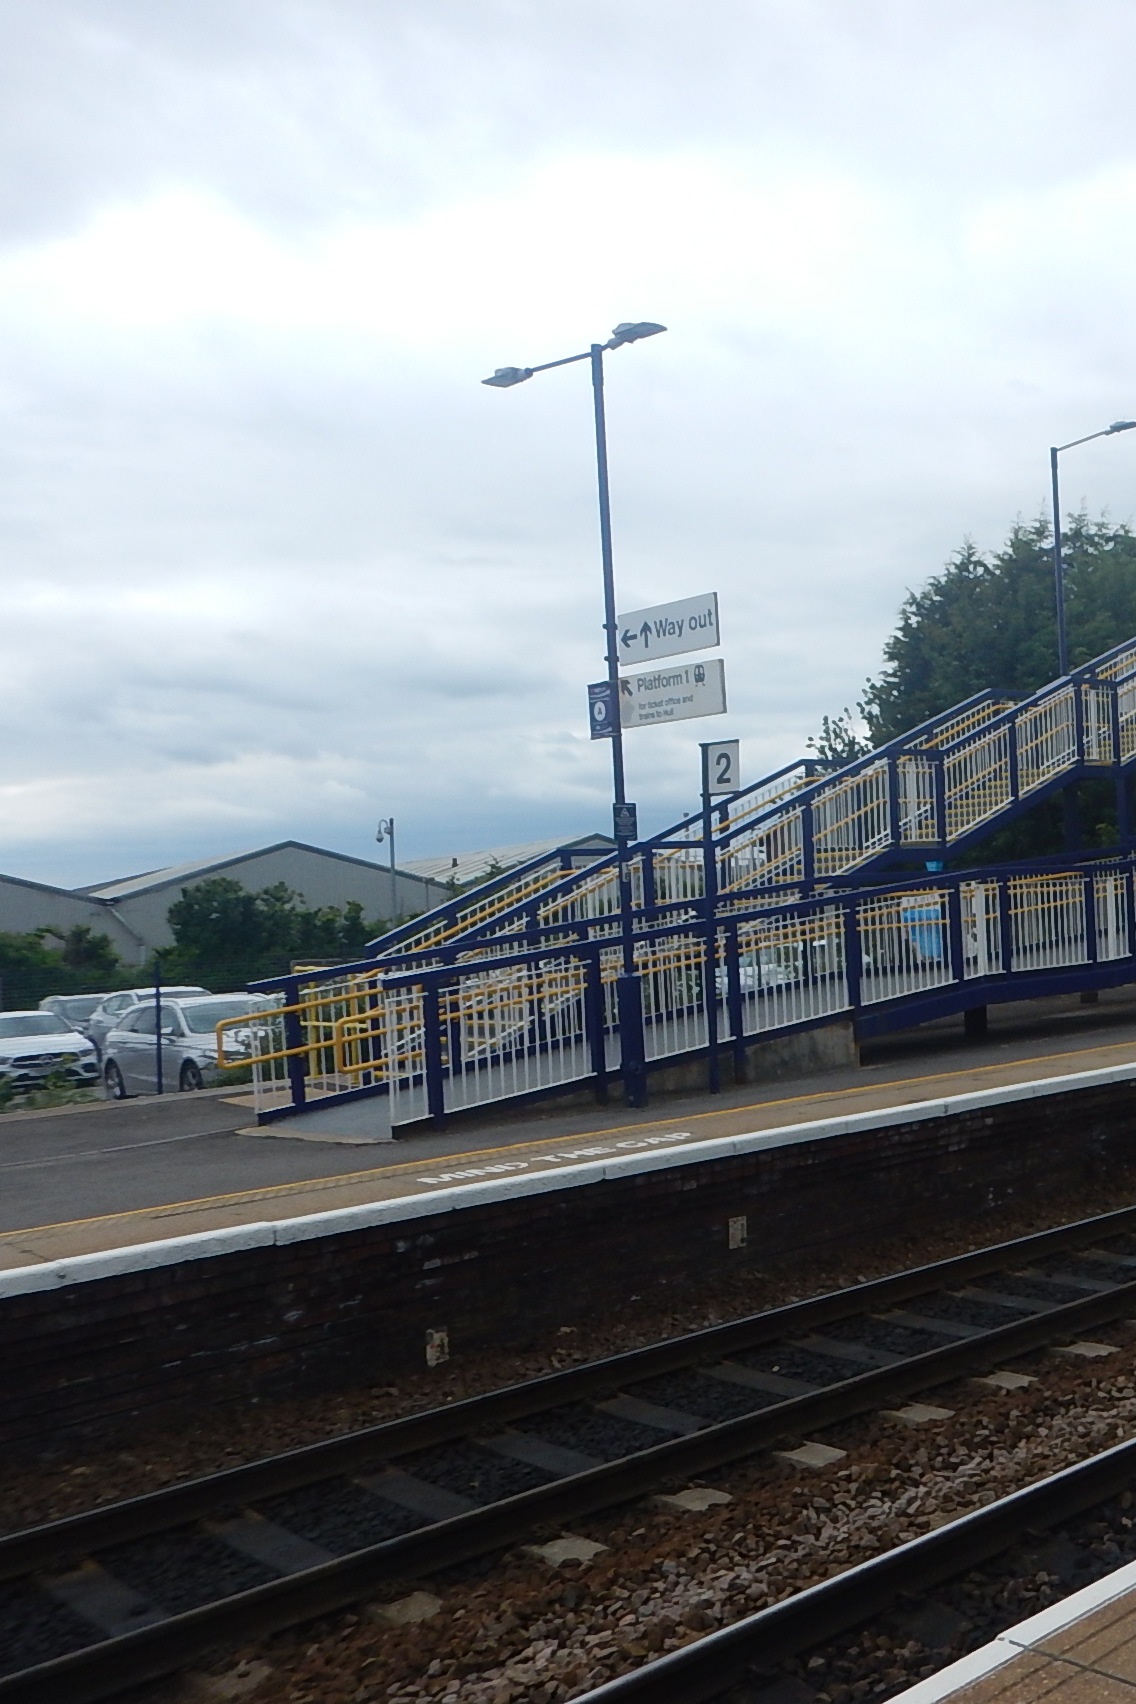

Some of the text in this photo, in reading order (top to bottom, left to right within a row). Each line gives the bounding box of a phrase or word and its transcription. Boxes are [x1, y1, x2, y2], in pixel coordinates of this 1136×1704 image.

[654, 608, 713, 637] Way out
[637, 669, 690, 692] Platform 1
[715, 752, 731, 785] 2
[416, 1132, 691, 1184] MIND THE GAP
